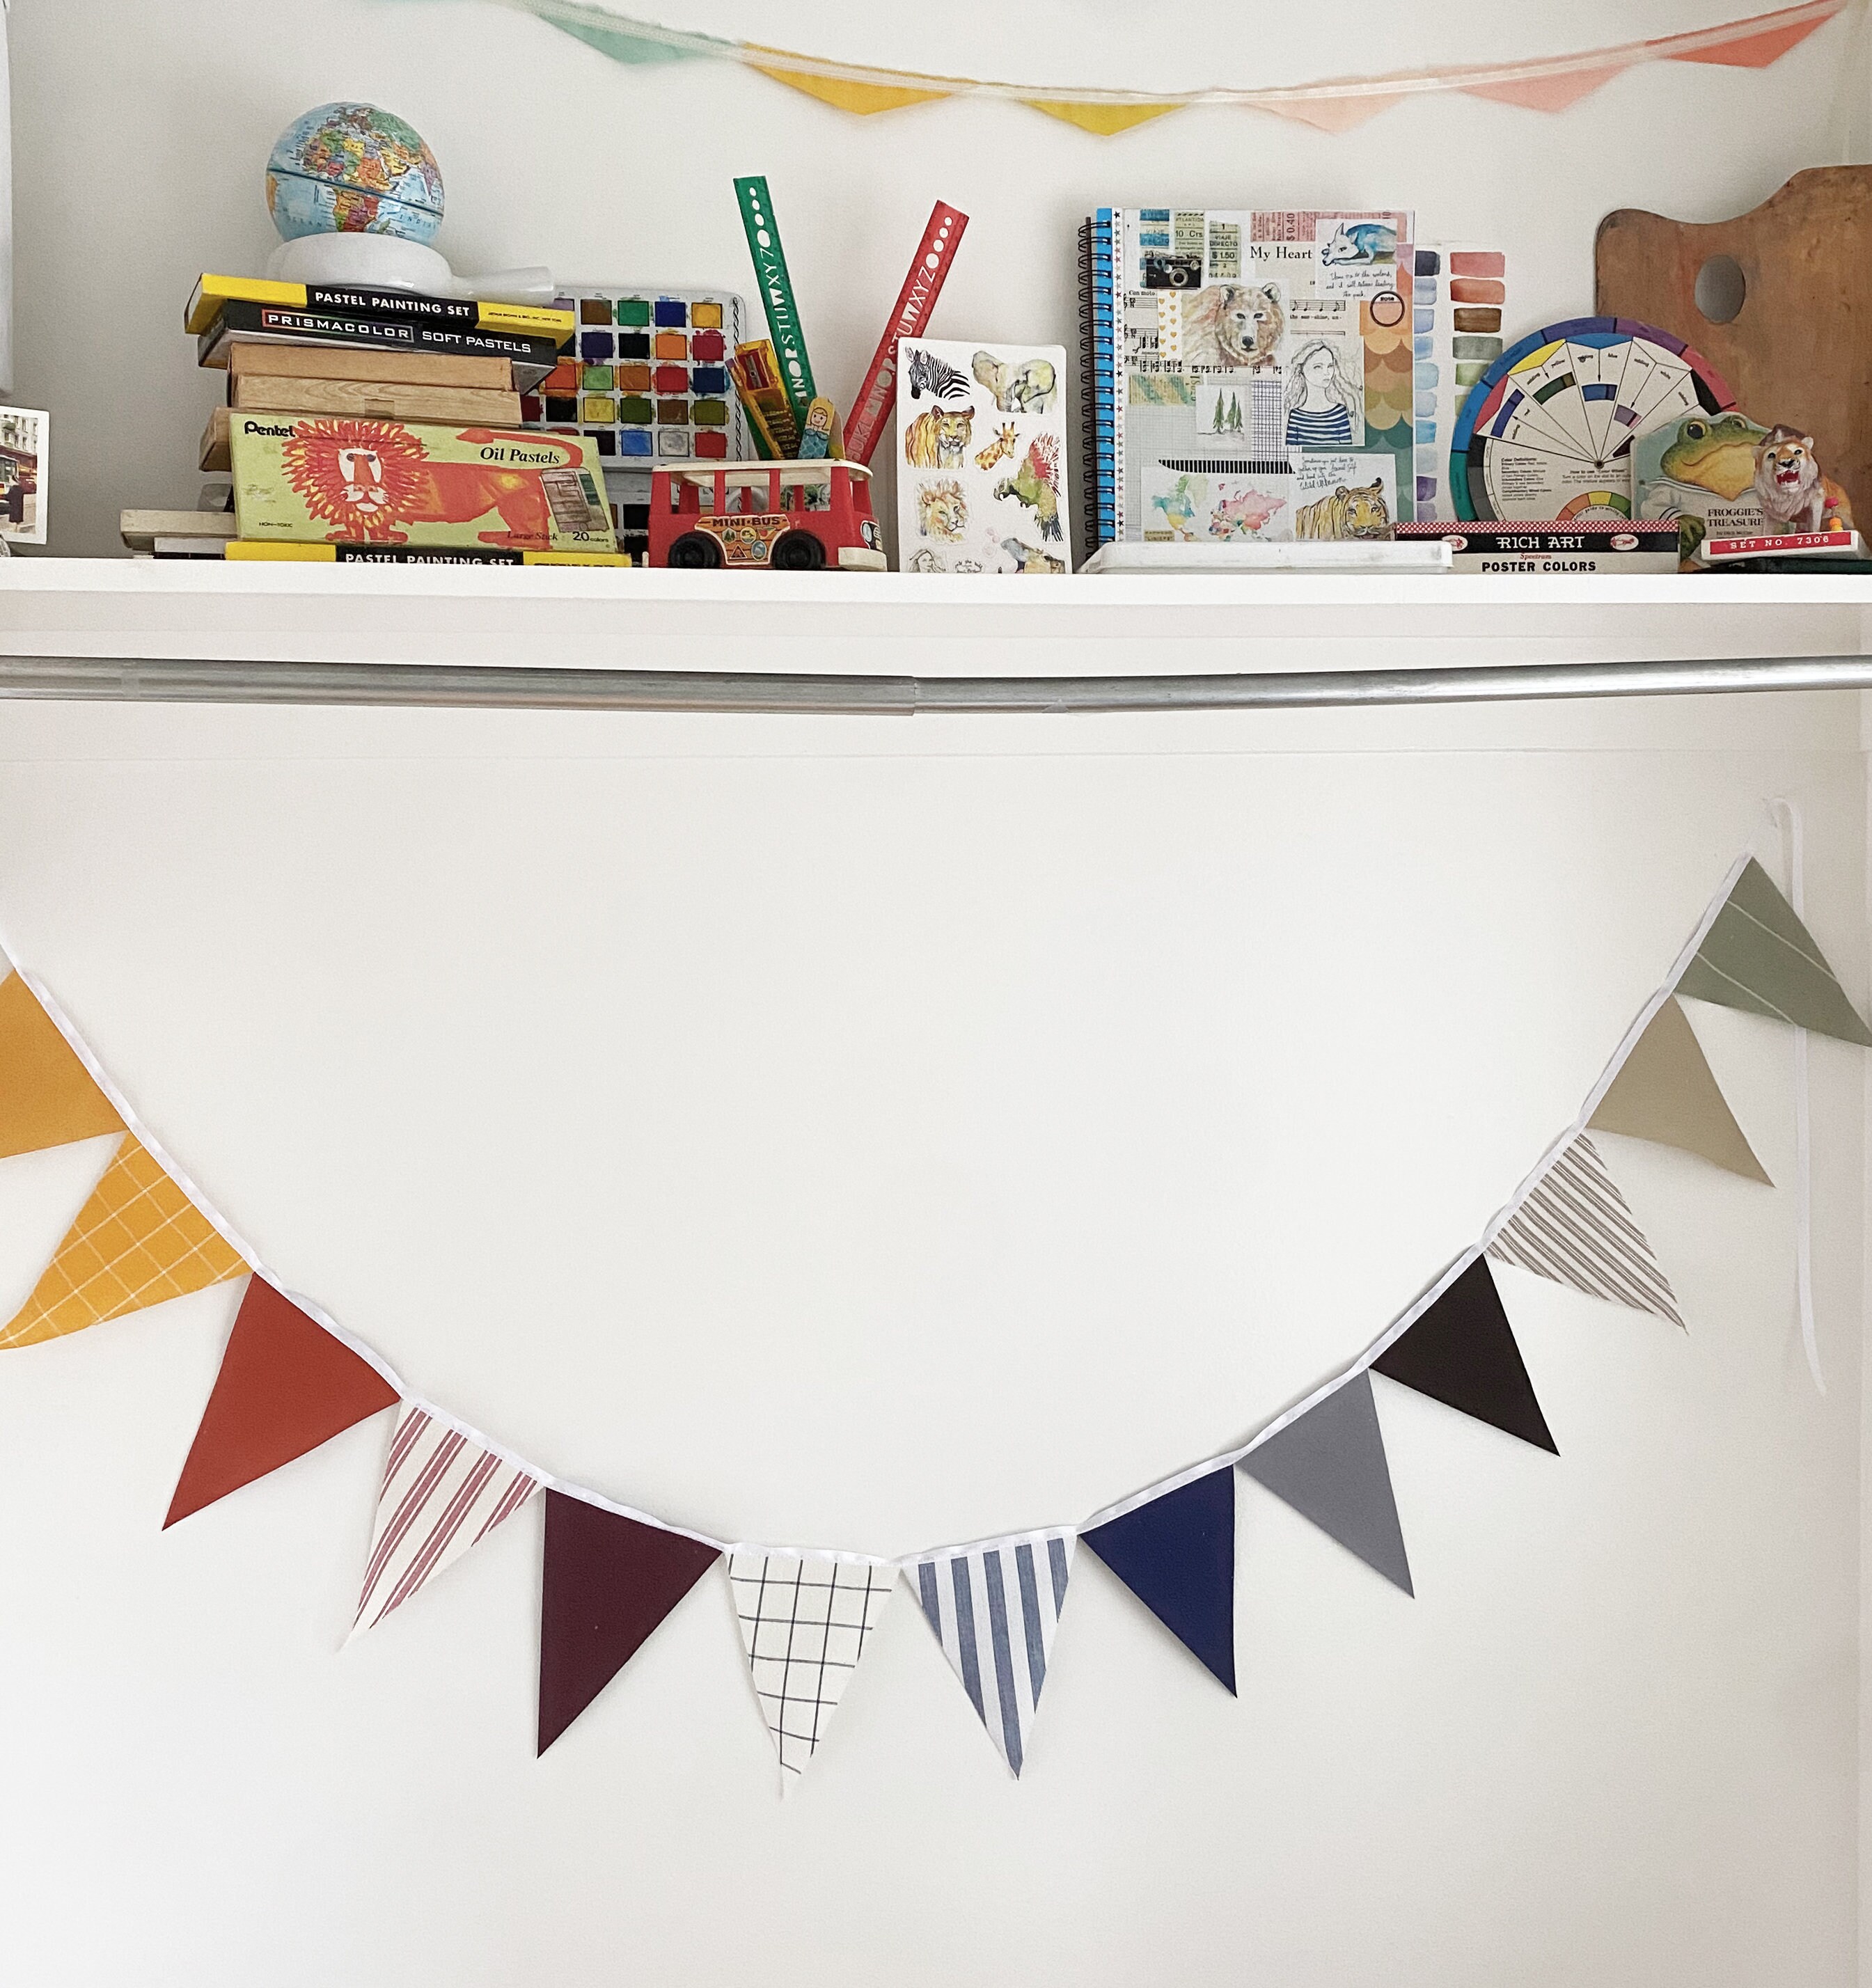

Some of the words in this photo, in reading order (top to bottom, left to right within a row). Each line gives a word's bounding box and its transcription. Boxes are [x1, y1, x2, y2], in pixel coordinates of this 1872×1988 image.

[1250, 246, 1271, 262] My
[1276, 246, 1313, 259] Heart
[315, 292, 366, 306] PASTEL
[372, 297, 441, 313] PAINTING
[448, 306, 469, 316] SET
[268, 315, 409, 338] PRISMACOLOR
[422, 331, 461, 344] SOFT
[466, 336, 531, 353] PASTELS
[244, 420, 296, 437] Pentel
[480, 447, 504, 461] Oil
[510, 448, 560, 464] Pastels
[1708, 507, 1763, 516] FROGGIE'S
[507, 531, 534, 540] Large
[535, 532, 558, 540] Stick
[572, 531, 590, 542] 20
[1496, 537, 1540, 549] RICH
[1548, 536, 1585, 549] ART
[1729, 541, 1756, 549] SET
[1797, 535, 1829, 545] 7306
[1481, 562, 1536, 572] POSTER
[1543, 561, 1596, 571] COLORS
